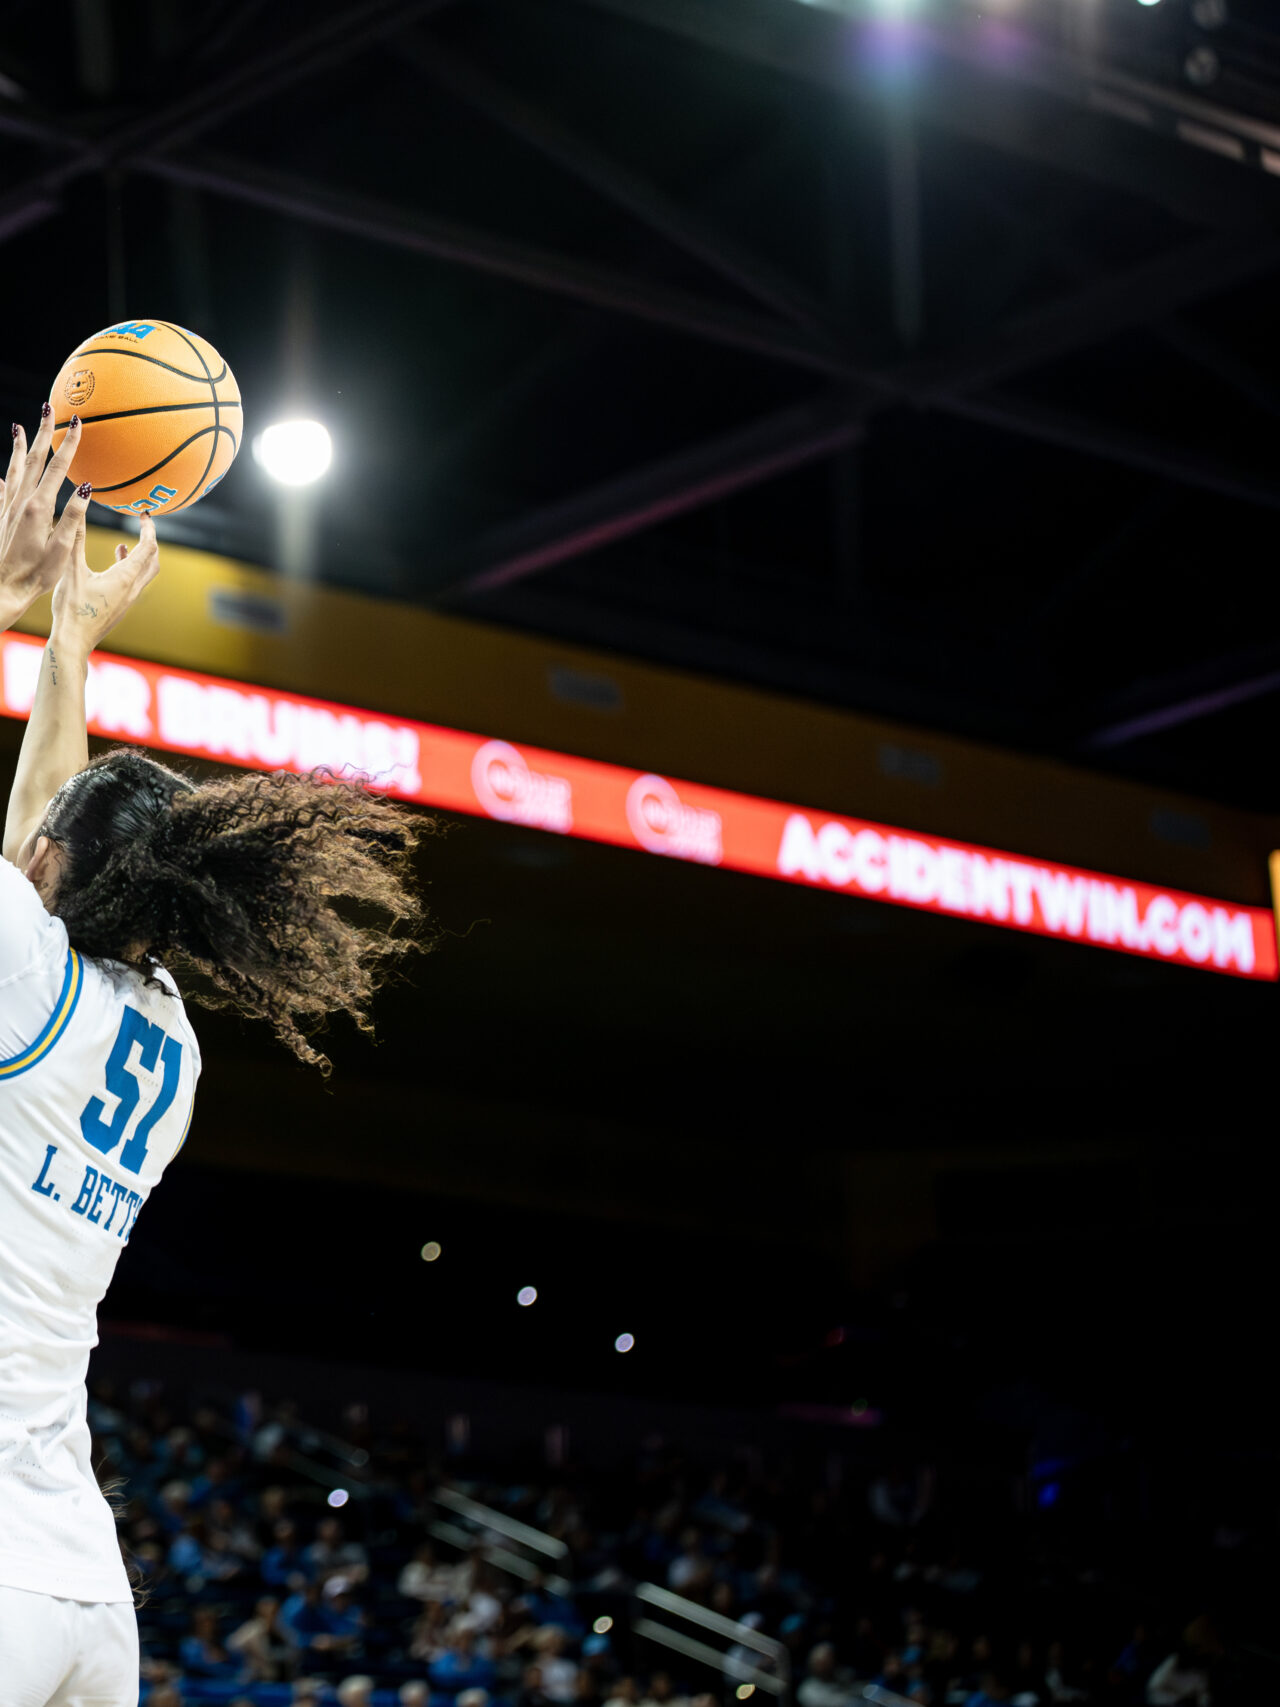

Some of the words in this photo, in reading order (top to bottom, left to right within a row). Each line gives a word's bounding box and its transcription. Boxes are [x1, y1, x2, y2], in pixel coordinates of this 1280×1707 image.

[2, 641, 154, 738] FR
[776, 813, 1256, 974] ACCIDENTWIN.COM
[80, 1004, 183, 1175] 51
[31, 1144, 61, 1202] L.
